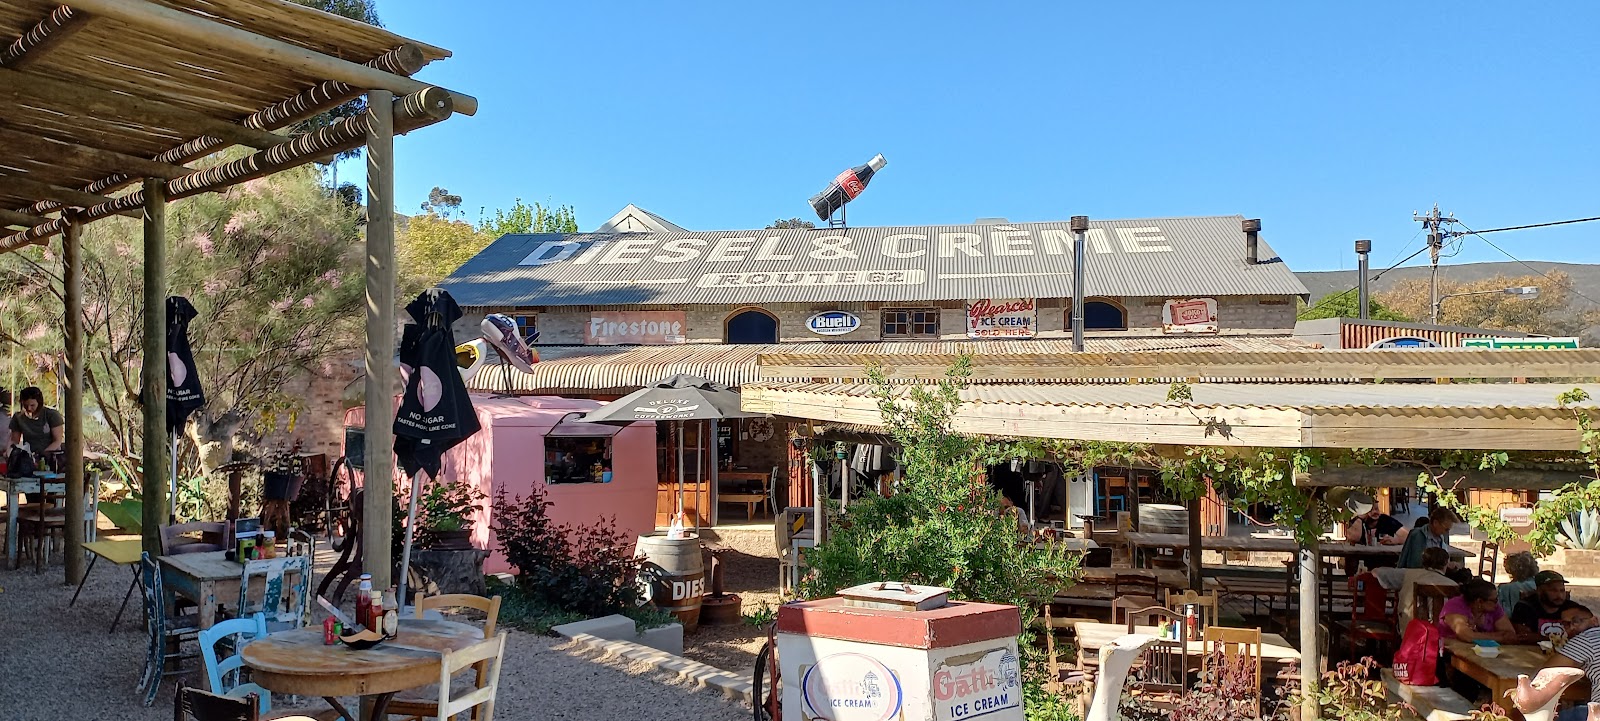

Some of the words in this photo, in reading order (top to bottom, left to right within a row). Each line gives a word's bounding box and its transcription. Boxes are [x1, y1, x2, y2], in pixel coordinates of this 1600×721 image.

[518, 235, 794, 266] DIESEL
[809, 235, 858, 260] &
[882, 225, 1173, 258] CRÈME
[714, 272, 857, 286] ROUTE
[867, 271, 904, 284] 62
[816, 315, 851, 327] Buell
[980, 317, 996, 326] ICE
[999, 316, 1031, 326] CREAM
[590, 317, 682, 339] Firestone
[409, 411, 422, 420] NO
[397, 417, 415, 427] TASTES
[831, 699, 841, 707] ICE
[844, 699, 871, 707] CREAM
[950, 703, 969, 718] ICE
[974, 693, 1009, 712] CREAM
